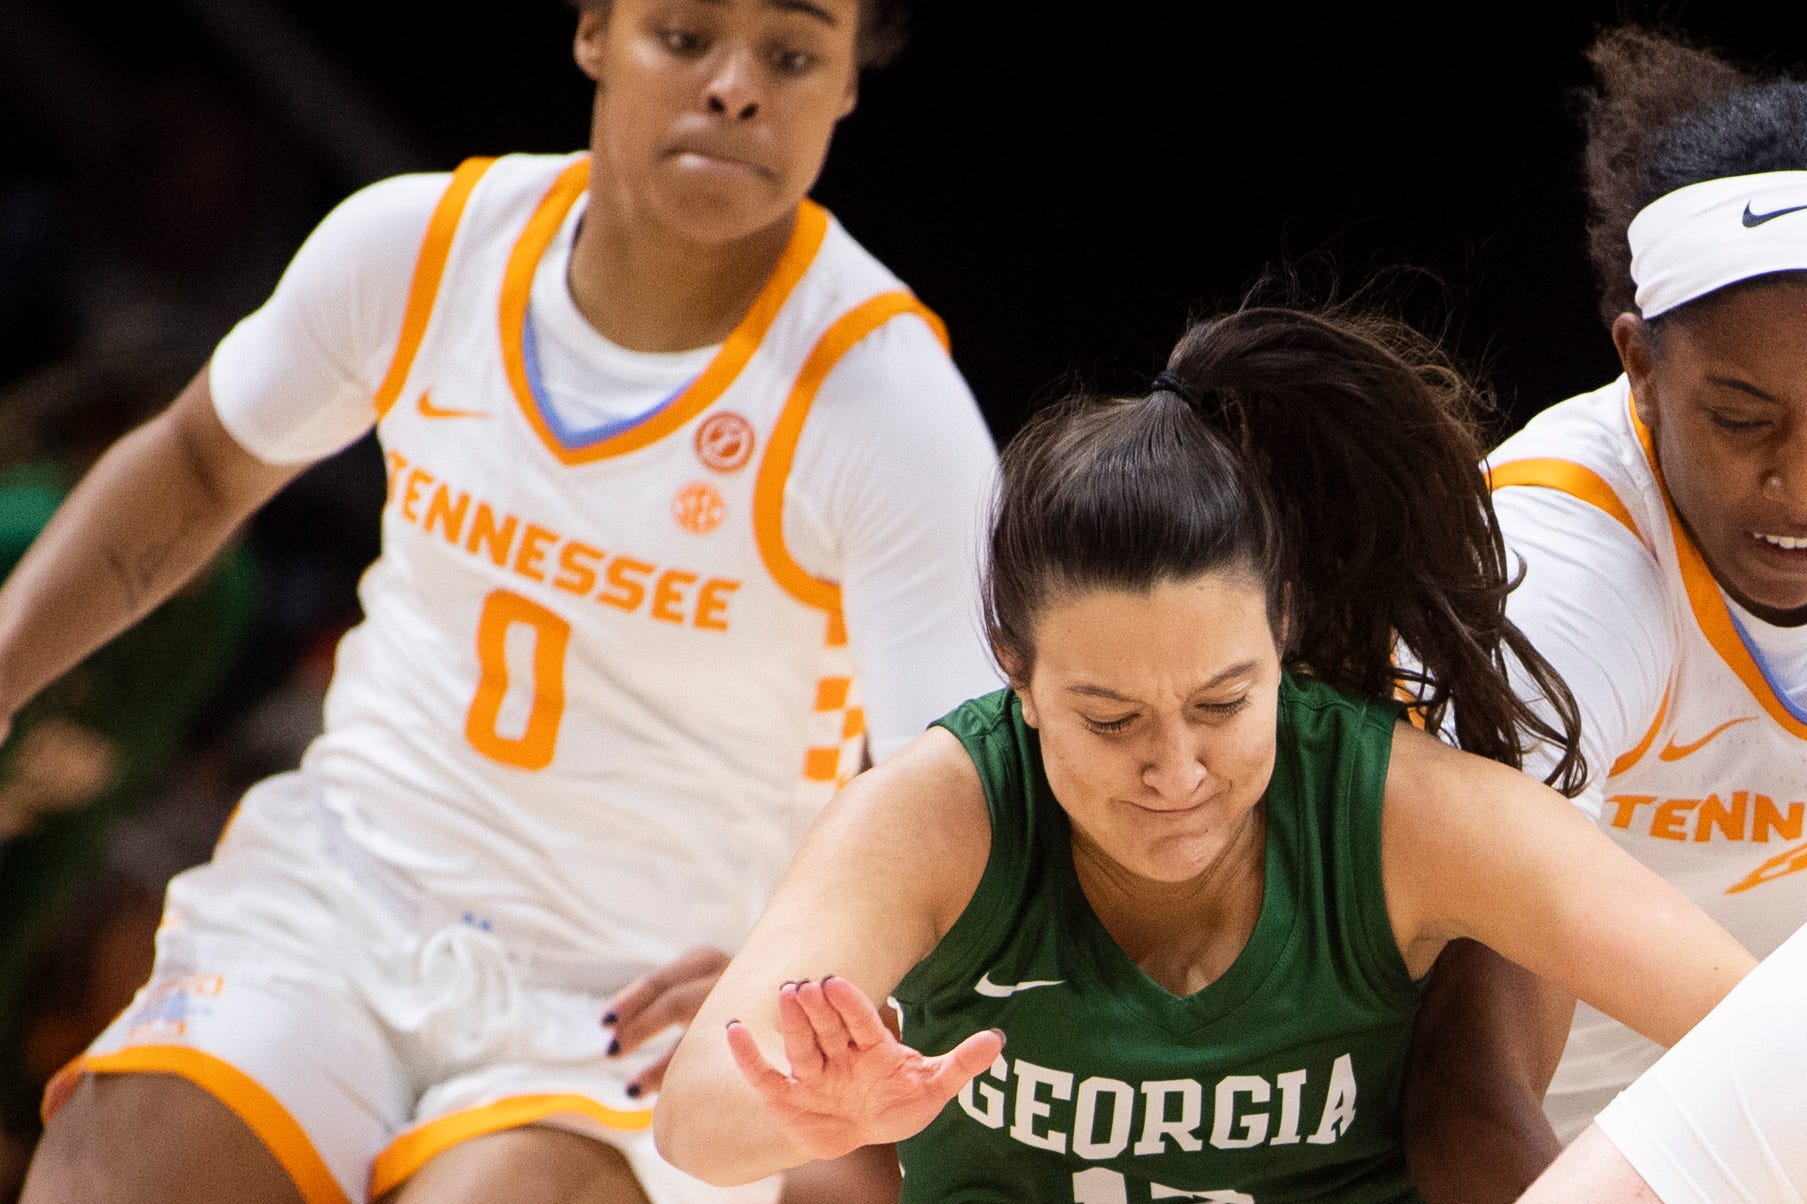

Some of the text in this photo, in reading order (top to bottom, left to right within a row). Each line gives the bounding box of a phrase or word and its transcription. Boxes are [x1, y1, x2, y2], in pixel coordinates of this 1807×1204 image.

[387, 450, 743, 632] TENNESSEE
[464, 586, 572, 773] 0
[957, 1052, 1357, 1160] GEORGIA
